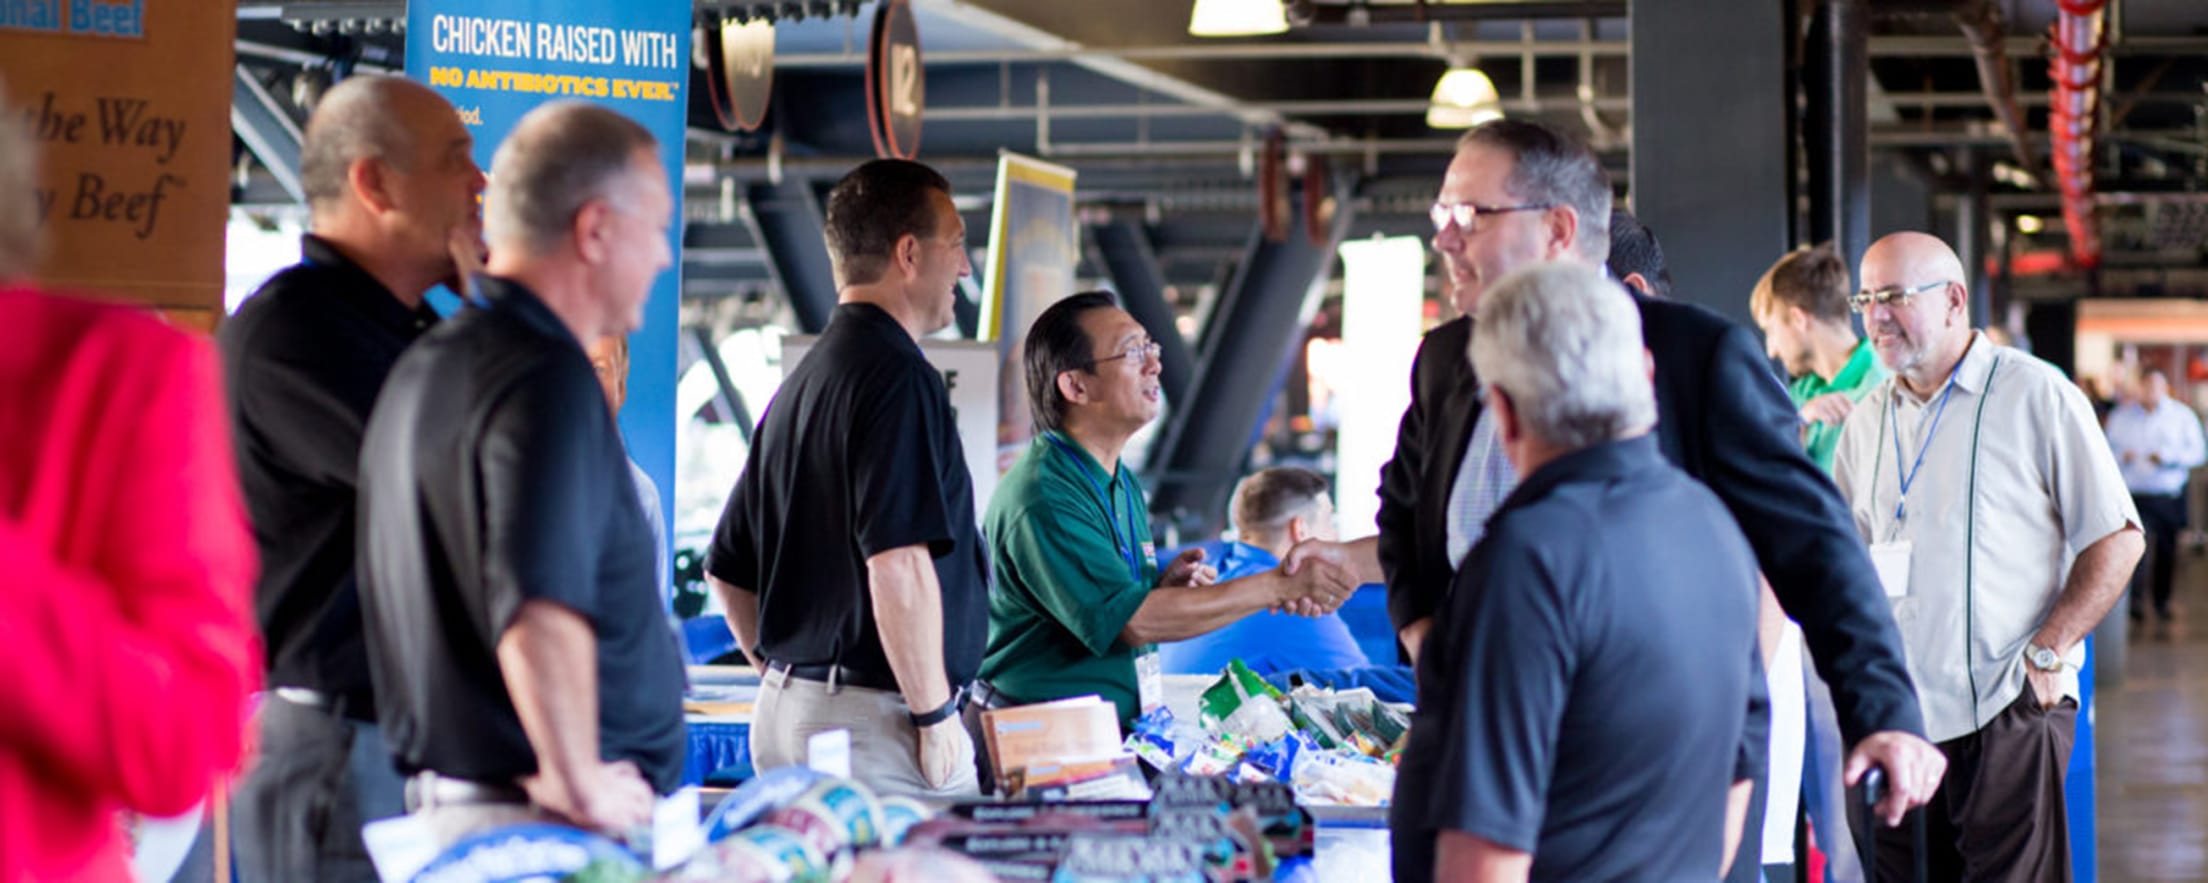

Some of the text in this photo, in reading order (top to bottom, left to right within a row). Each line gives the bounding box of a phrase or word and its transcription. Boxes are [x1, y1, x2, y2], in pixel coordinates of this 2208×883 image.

[70, 0, 144, 37] Beef
[432, 14, 532, 59] CHICKEN
[536, 22, 616, 65] RAISED
[621, 29, 677, 69] WITH
[430, 67, 464, 88] NO
[466, 70, 608, 97] ANTIBIOTICS
[97, 97, 186, 164] Way
